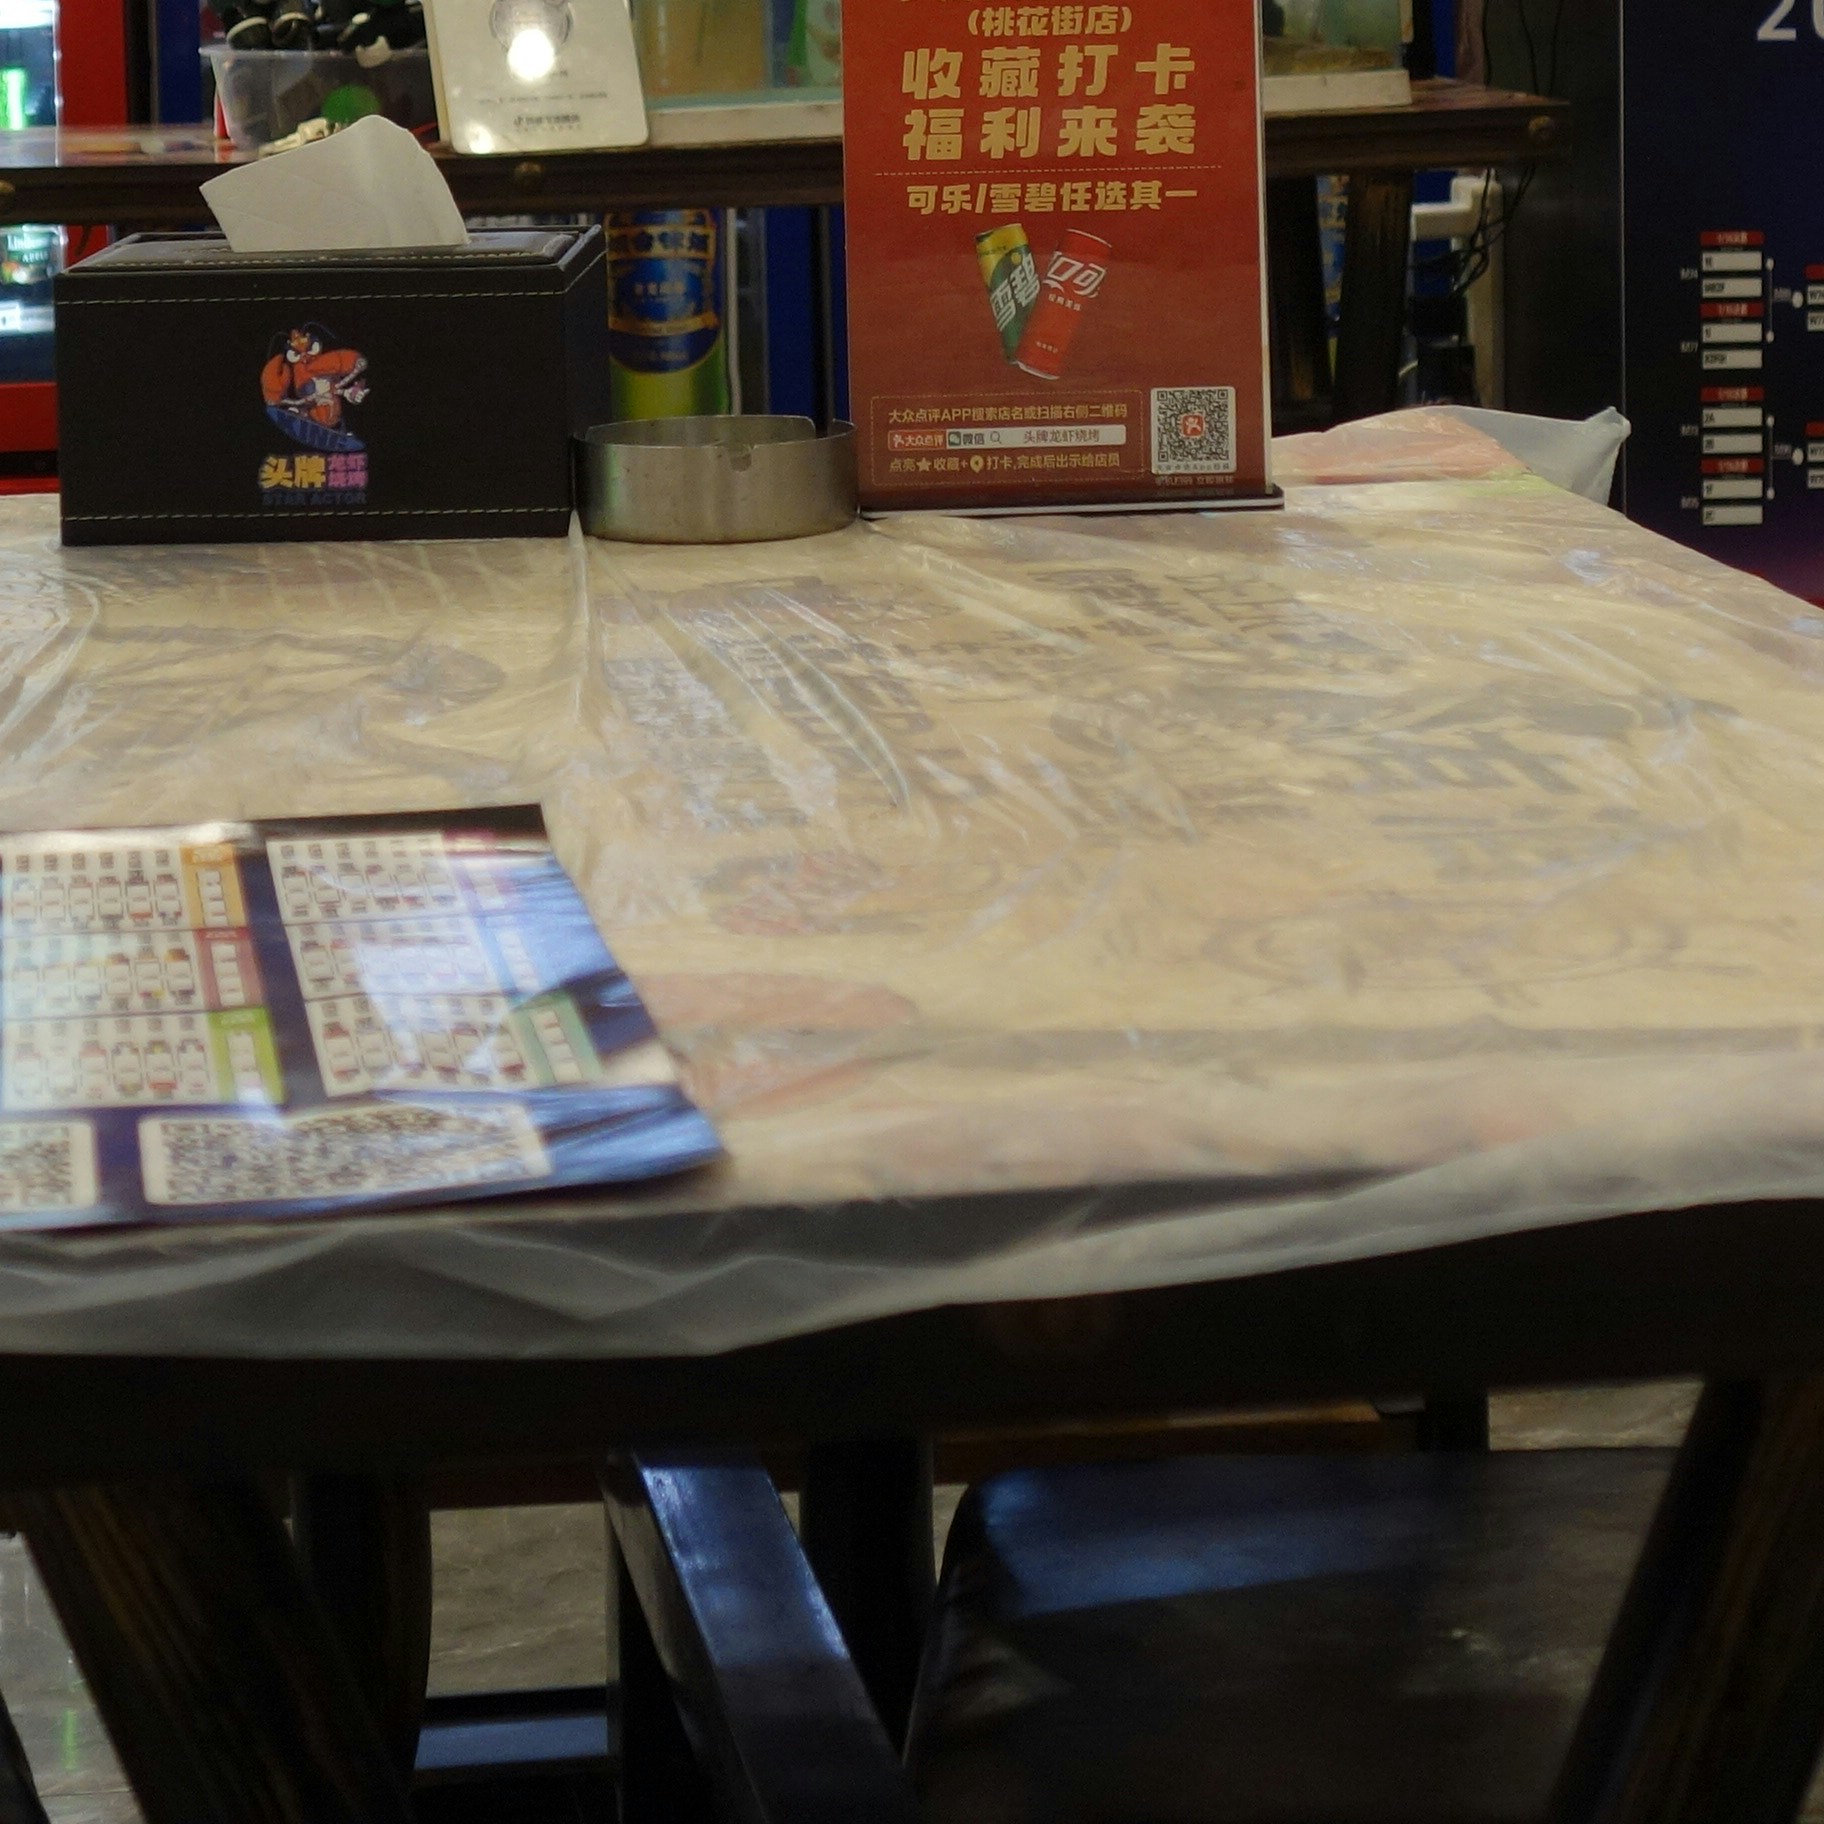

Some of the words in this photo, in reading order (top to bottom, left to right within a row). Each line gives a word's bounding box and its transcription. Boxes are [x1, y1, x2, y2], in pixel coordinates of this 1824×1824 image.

[968, 6, 1133, 37] (桃花街店)
[902, 43, 1195, 100] 收藏打卡
[902, 104, 1197, 161] 福利来袭
[906, 180, 1198, 215] 可乐/雪碧任选其一
[990, 253, 1041, 334] 雪碧
[1023, 428, 1100, 445] 头牌龙虾烧烤
[260, 455, 326, 490] 头牌
[889, 457, 916, 473] 点亮
